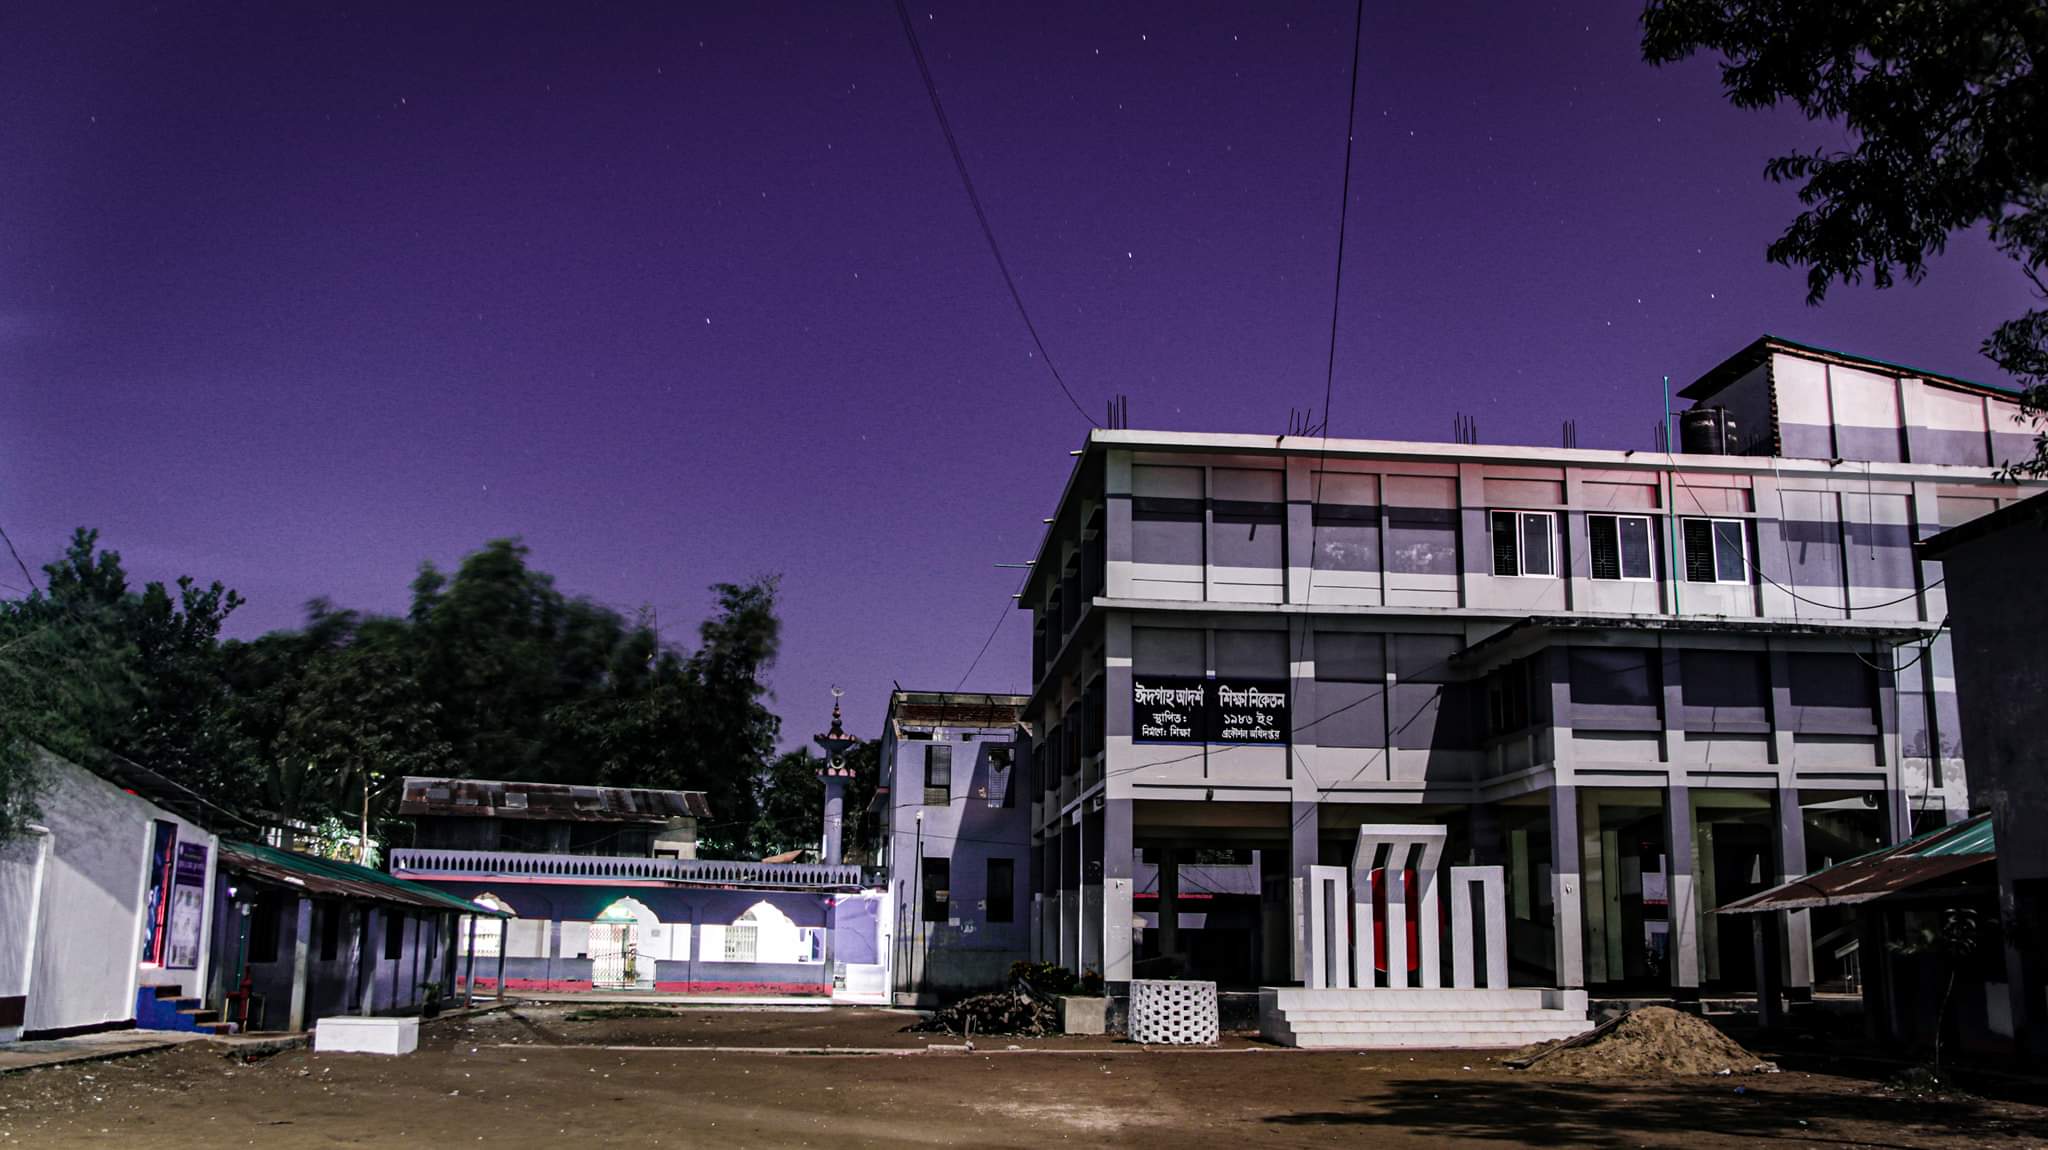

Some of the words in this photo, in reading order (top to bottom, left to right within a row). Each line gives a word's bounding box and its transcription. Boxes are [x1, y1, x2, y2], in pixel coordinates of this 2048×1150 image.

[1134, 681, 1175, 708] ঈদগাহ
[1175, 684, 1204, 708] আদর্শ
[1217, 685, 1248, 708] শিক্ষা
[1248, 686, 1286, 709] নিকেতন
[1224, 714, 1253, 724] ১৯৮৬
[1256, 711, 1275, 726] ইং
[1170, 724, 1191, 738] শিক্ষা
